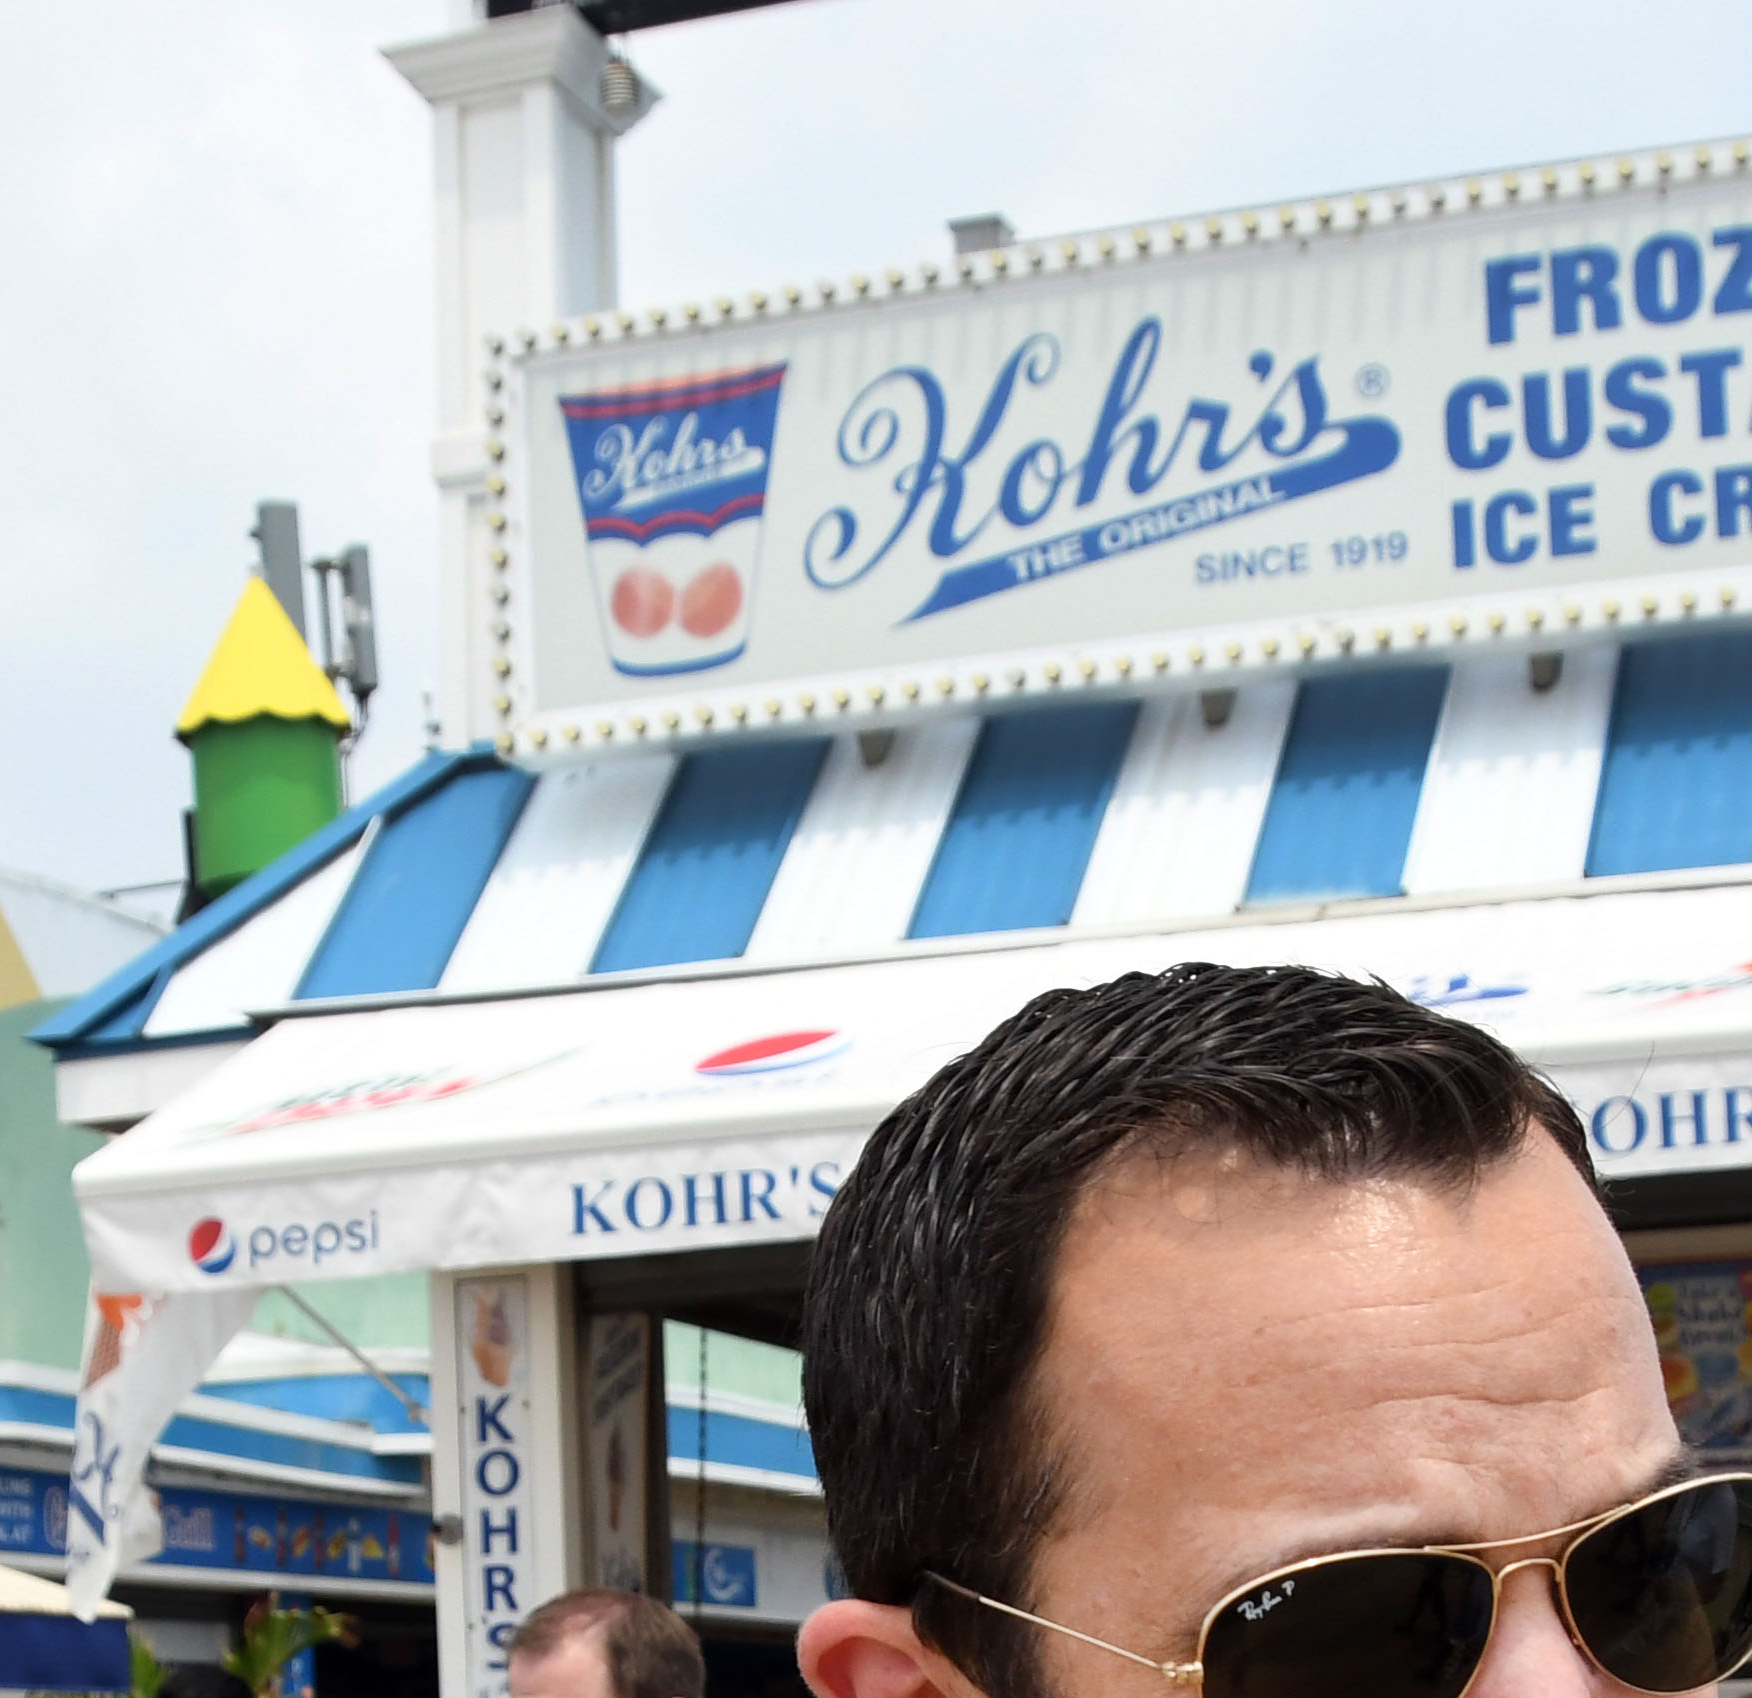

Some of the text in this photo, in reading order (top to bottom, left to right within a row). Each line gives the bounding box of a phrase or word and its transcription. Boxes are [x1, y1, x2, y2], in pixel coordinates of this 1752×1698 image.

[804, 315, 1328, 591] Kohr's
[1007, 476, 1286, 583] THE ORIGINAL
[1195, 532, 1408, 587] SINCE 1919
[1451, 482, 1596, 568] ICE
[248, 1209, 380, 1270] pepsi
